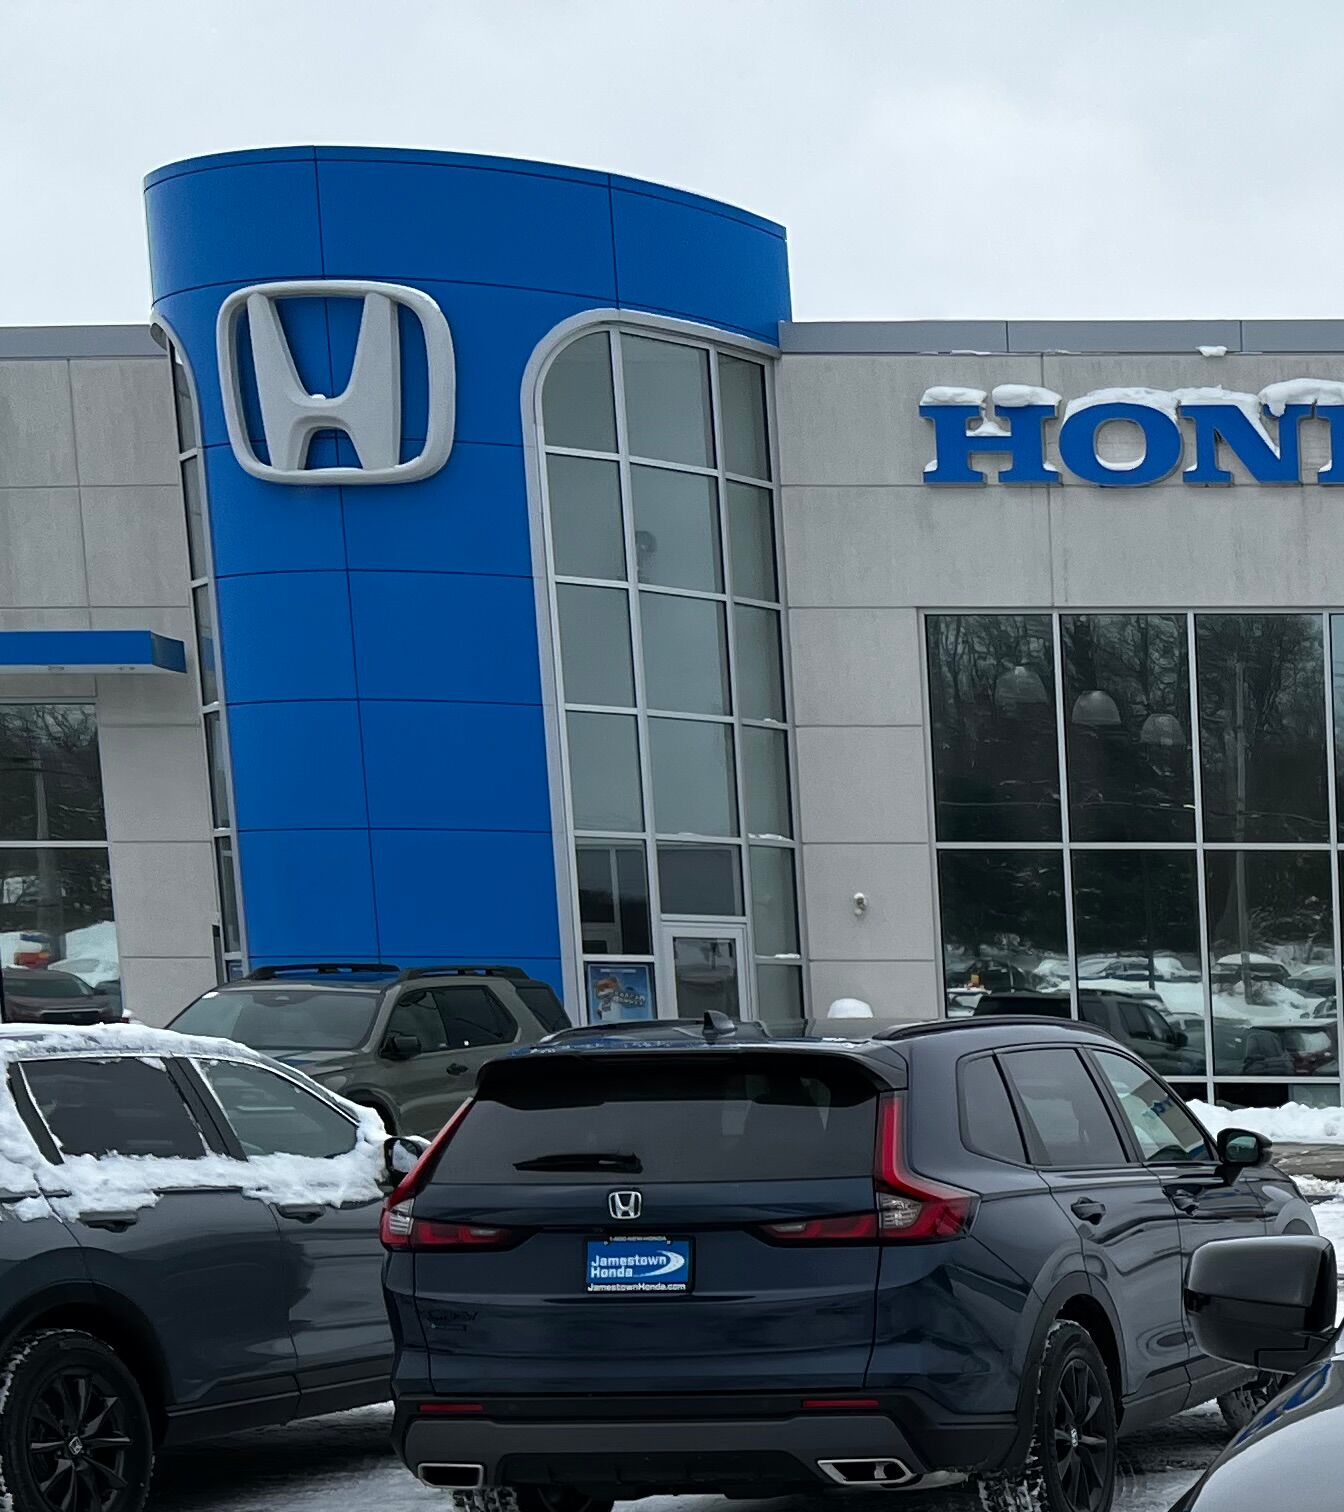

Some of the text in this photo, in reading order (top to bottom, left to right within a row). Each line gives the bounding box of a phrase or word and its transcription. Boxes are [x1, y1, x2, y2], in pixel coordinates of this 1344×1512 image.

[591, 1254, 667, 1267] Jamestown
[590, 1267, 633, 1278] Honda
[587, 1282, 686, 1292] JamestownHonda.com
